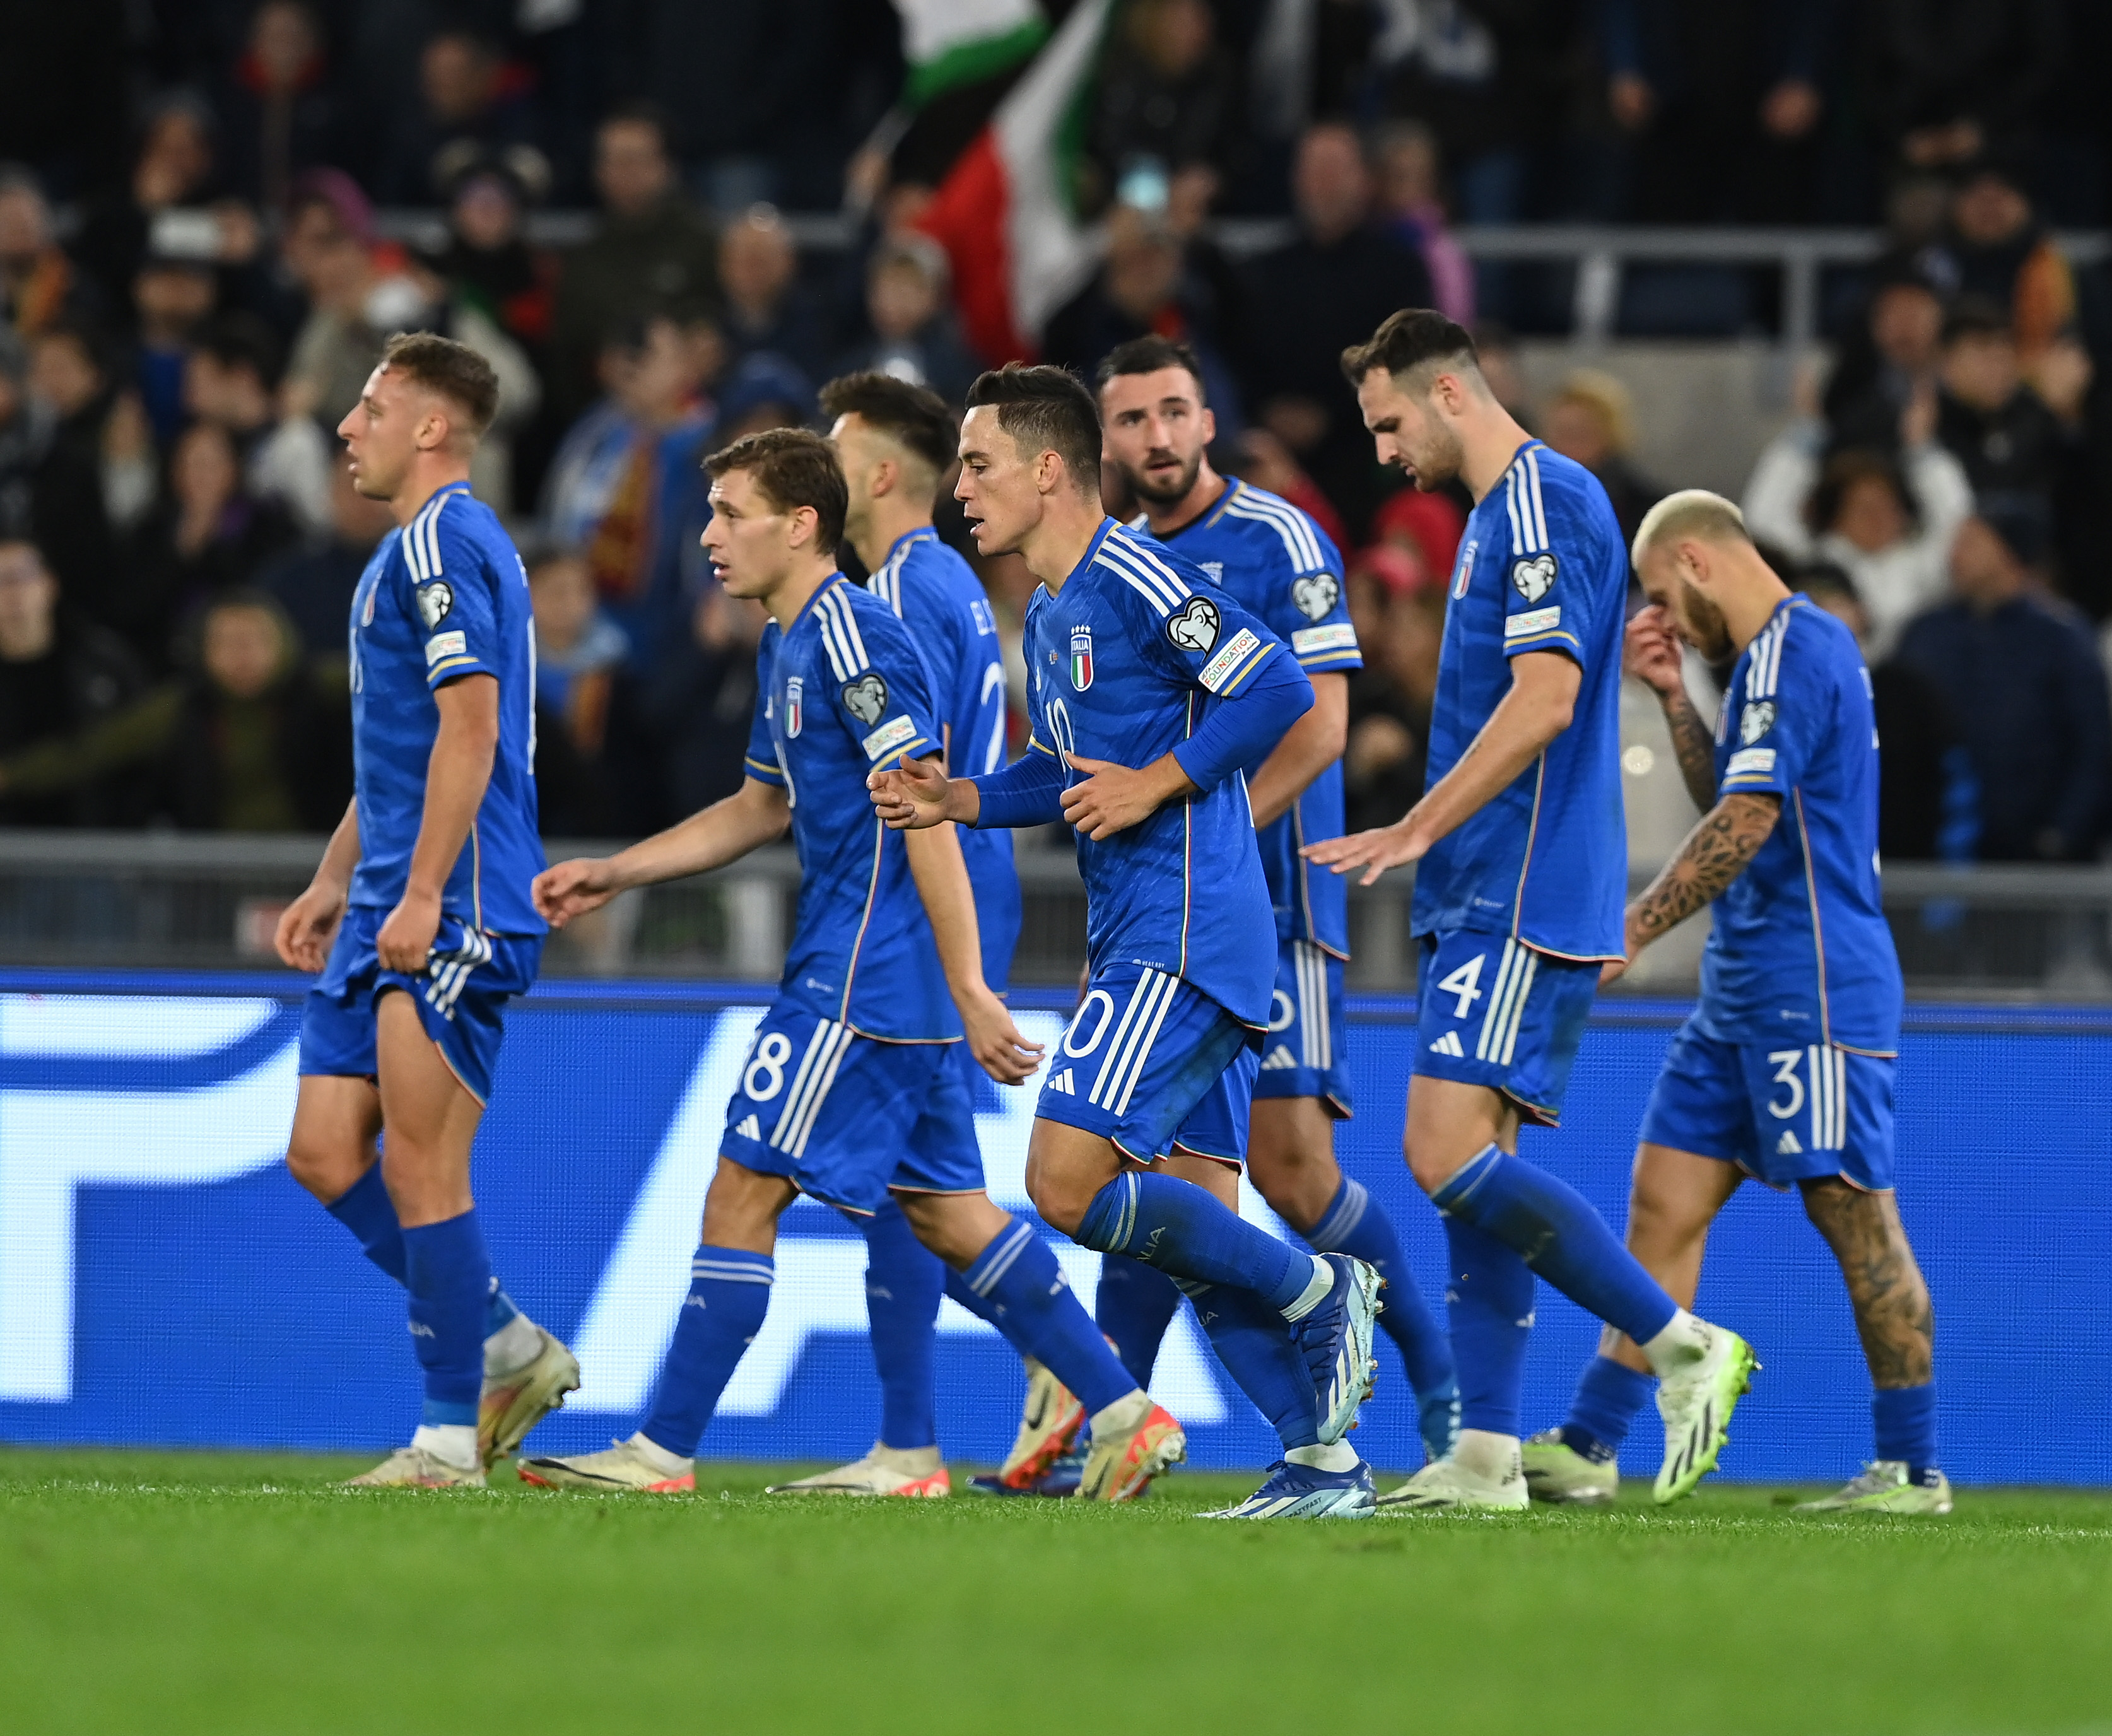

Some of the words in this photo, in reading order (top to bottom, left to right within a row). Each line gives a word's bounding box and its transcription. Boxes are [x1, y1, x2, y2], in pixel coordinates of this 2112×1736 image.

[1205, 633, 1253, 686] FOUNDATION
[1437, 953, 1486, 1019] 4
[1768, 1050, 1806, 1120] 3
